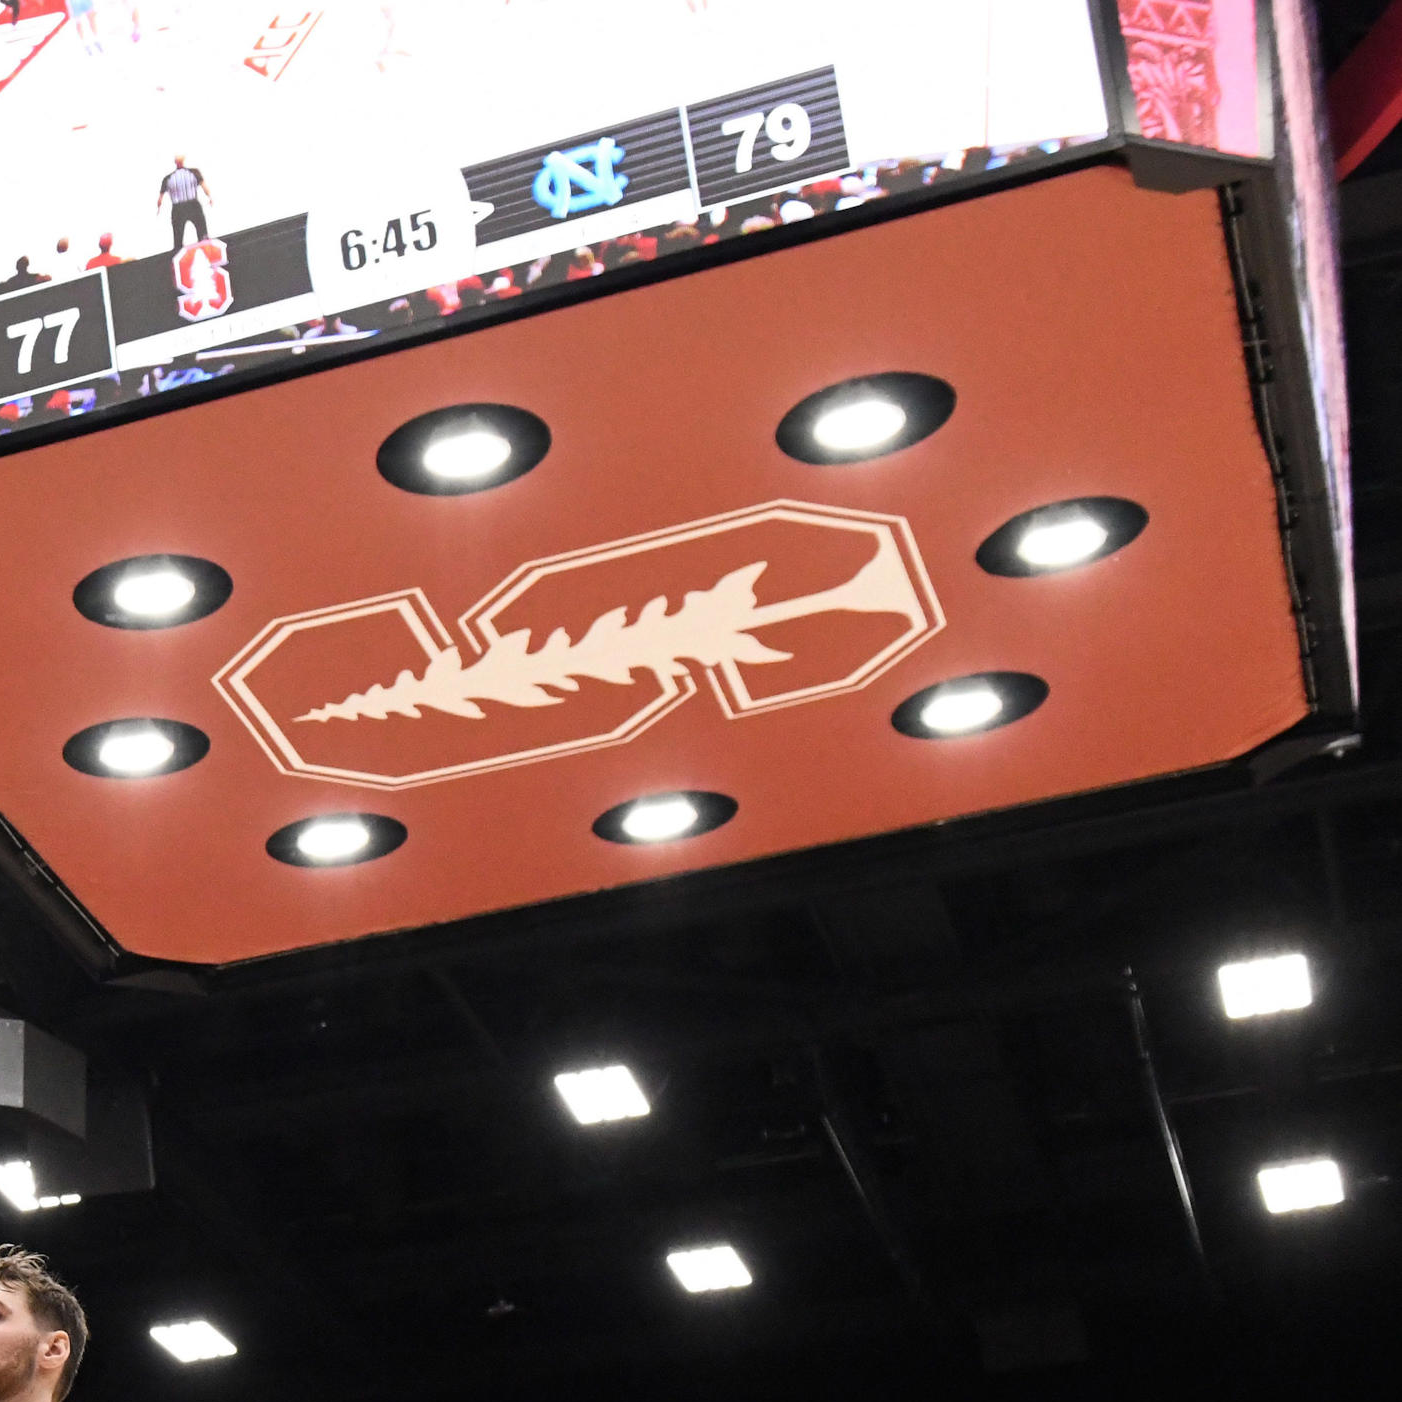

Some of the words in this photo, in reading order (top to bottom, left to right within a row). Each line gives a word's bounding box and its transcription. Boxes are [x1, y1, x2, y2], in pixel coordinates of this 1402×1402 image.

[721, 103, 812, 174] 79
[339, 208, 438, 272] 6:45
[7, 306, 81, 375] 77
